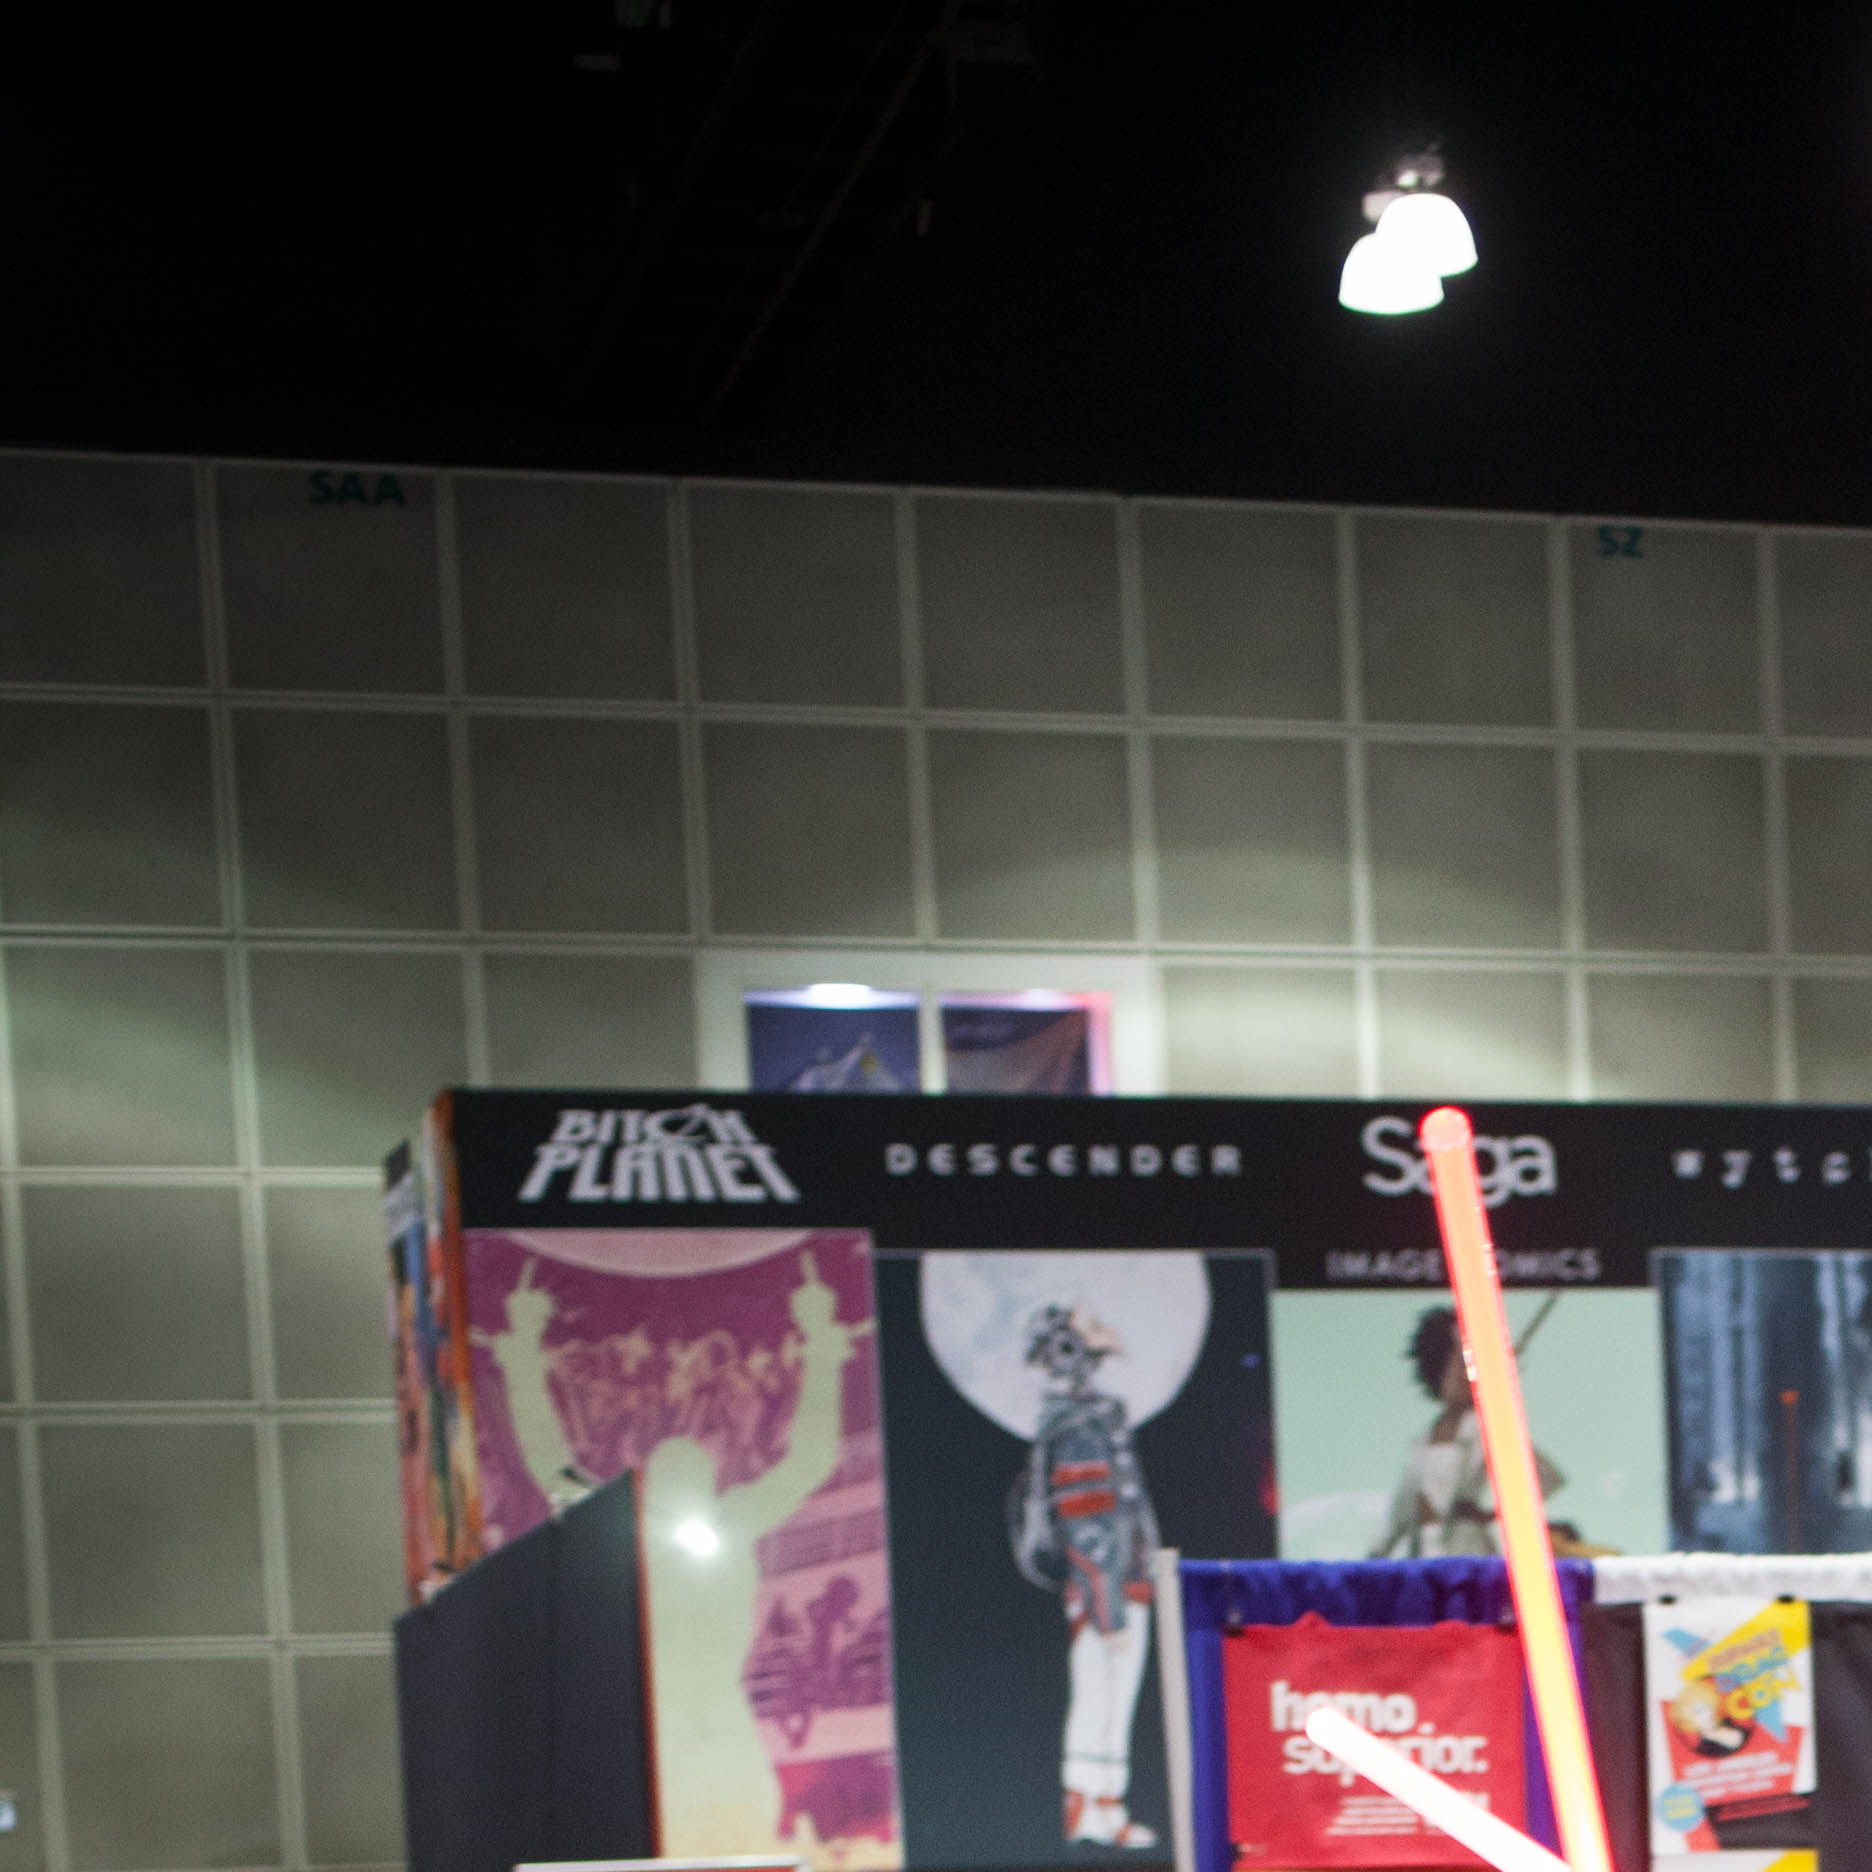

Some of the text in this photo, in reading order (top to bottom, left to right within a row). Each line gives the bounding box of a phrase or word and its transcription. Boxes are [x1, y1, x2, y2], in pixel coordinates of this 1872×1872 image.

[518, 1143, 801, 1201] PLANET
[885, 1144, 1244, 1176] DESCENDER
[1360, 1114, 1559, 1209] Sga
